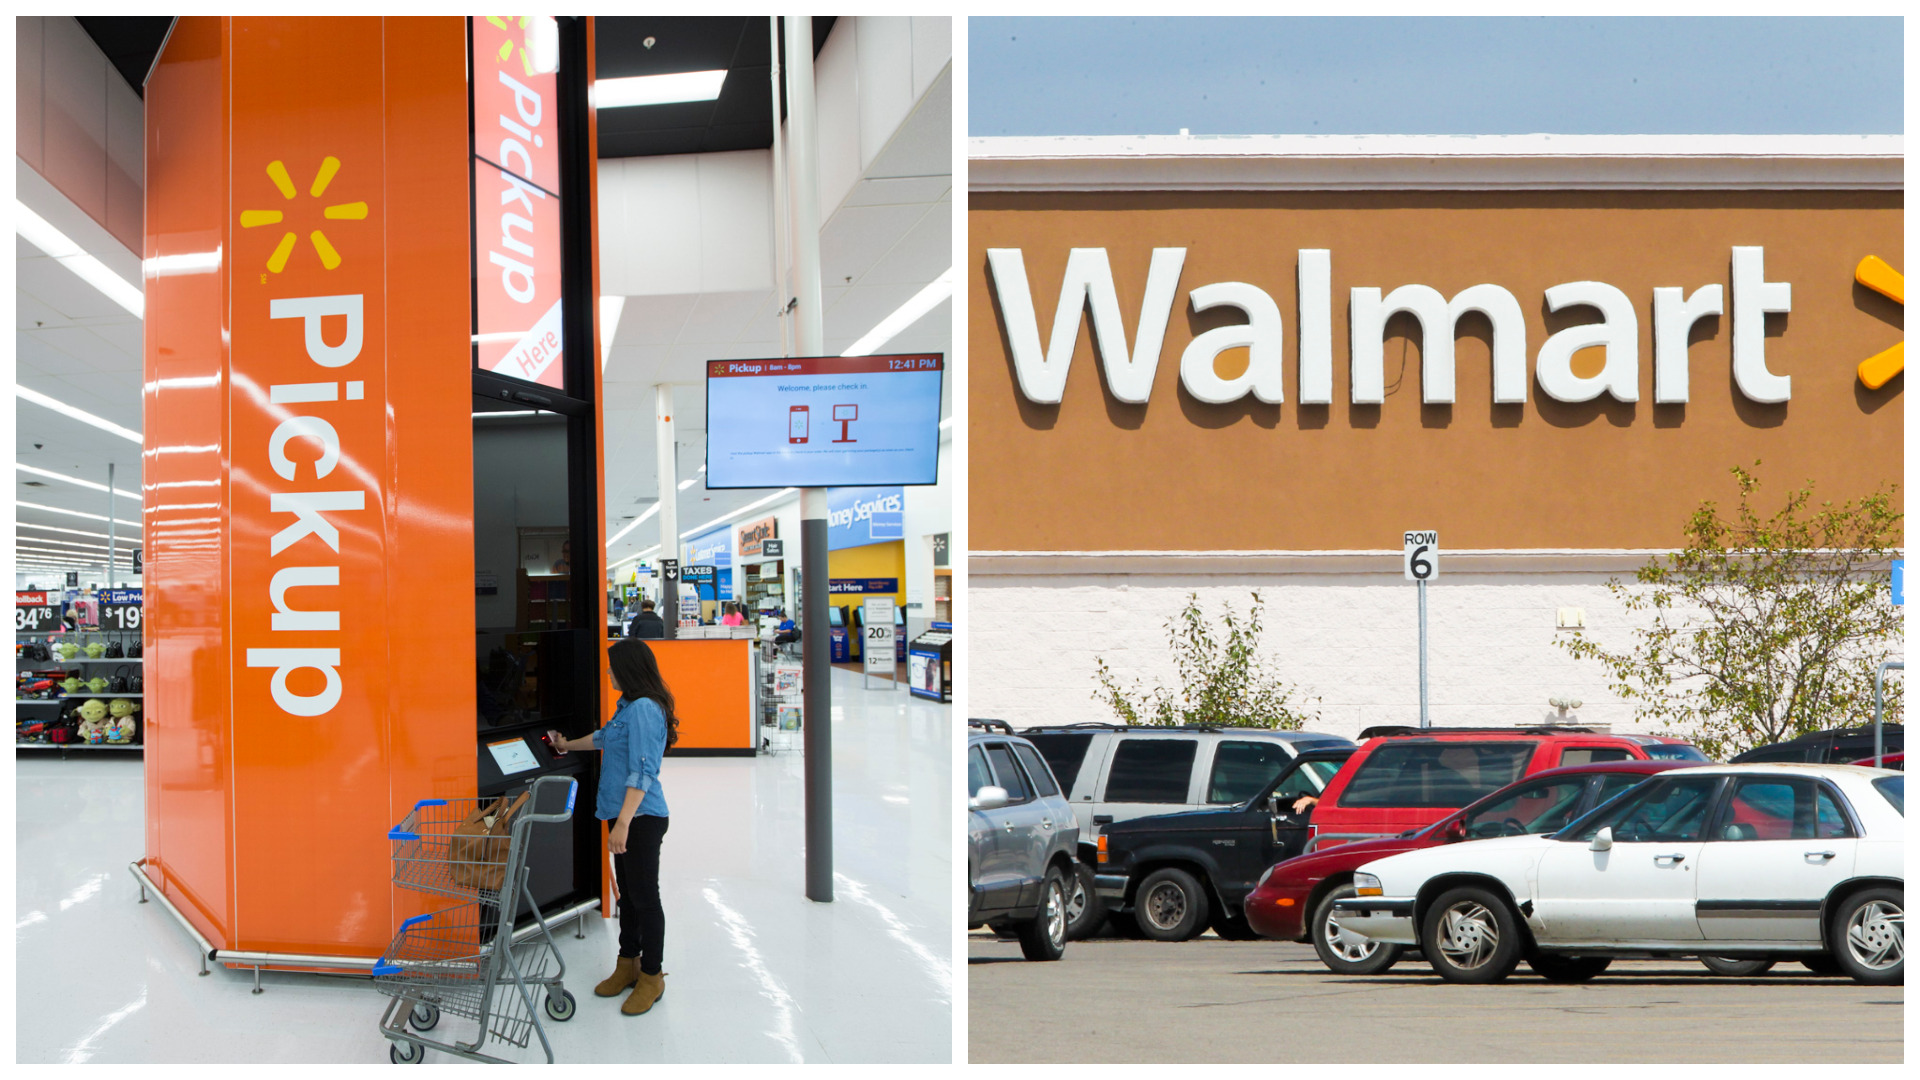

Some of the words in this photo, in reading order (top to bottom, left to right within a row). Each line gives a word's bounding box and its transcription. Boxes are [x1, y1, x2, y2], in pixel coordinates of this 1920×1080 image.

[489, 70, 546, 304] Pickup
[985, 246, 1792, 404] Walmart
[515, 329, 559, 377] Here
[888, 359, 915, 370] 12:41
[919, 359, 937, 369] PM
[728, 363, 762, 374] Pickup
[812, 384, 836, 393] please
[837, 383, 859, 391] check
[246, 294, 365, 717] Pickup
[828, 508, 854, 530] oney
[854, 494, 901, 522] Services
[1404, 533, 1437, 545] ROW
[683, 566, 713, 575] TAXES
[1410, 545, 1432, 579] 6
[843, 583, 863, 591] Here
